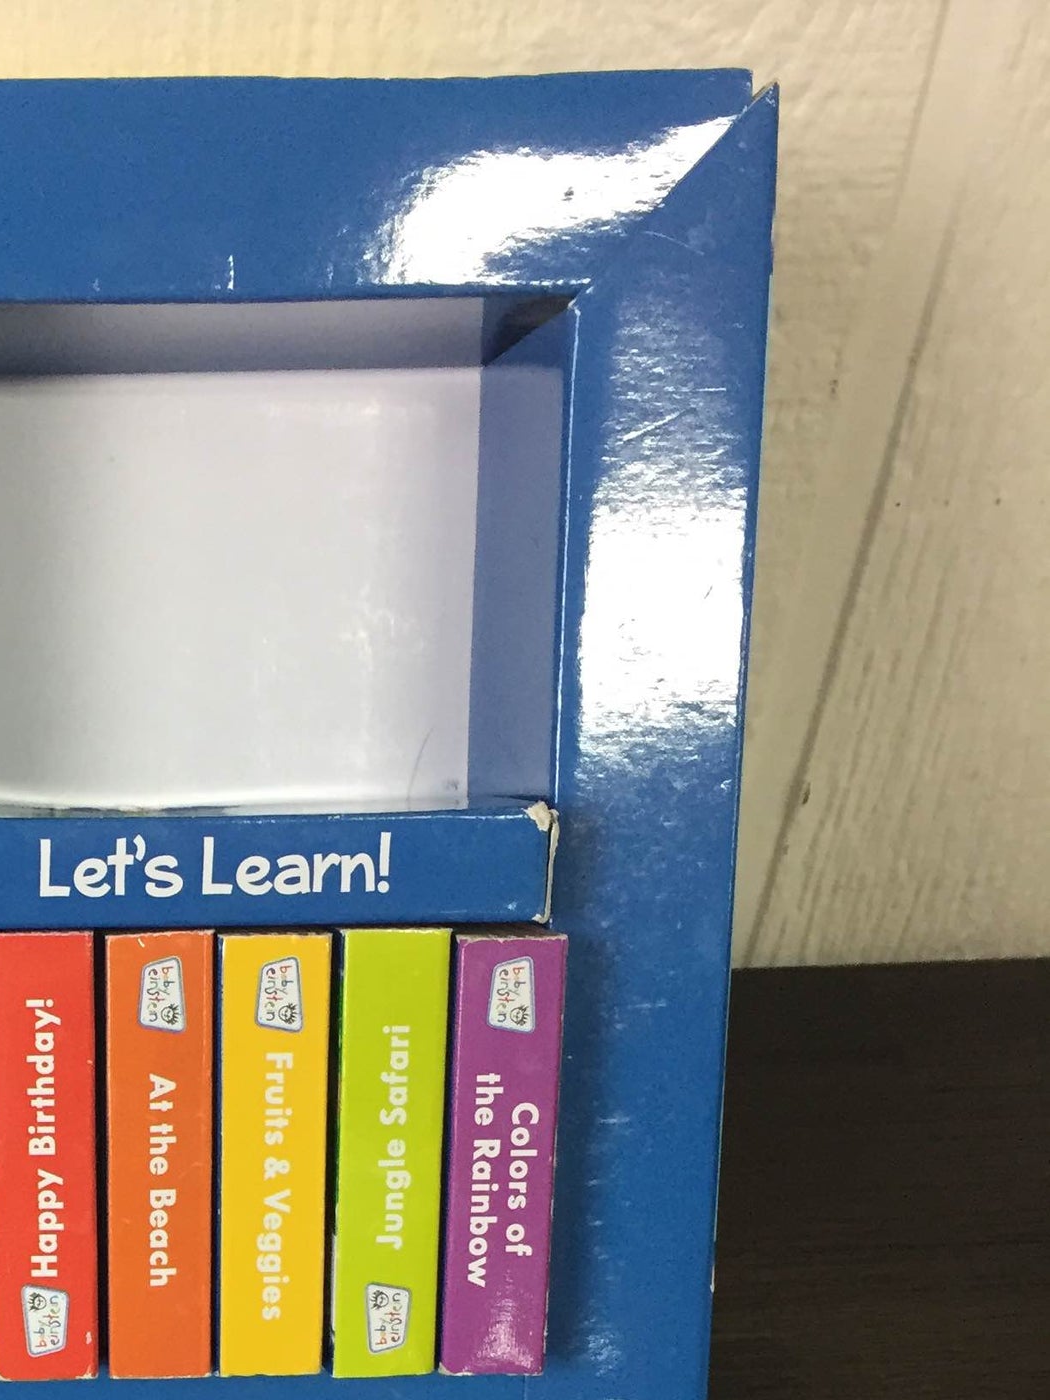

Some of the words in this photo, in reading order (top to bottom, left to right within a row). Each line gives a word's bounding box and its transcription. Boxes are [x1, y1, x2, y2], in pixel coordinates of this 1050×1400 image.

[39, 835, 184, 897] Let's
[202, 831, 391, 896] Learn!
[25, 998, 64, 1157] Birthday!
[148, 1072, 178, 1111] At
[265, 1051, 294, 1148] Fruits
[381, 1024, 411, 1126] Safari
[475, 1072, 505, 1128] the
[149, 1117, 177, 1176] the
[262, 1156, 291, 1182] &
[376, 1137, 411, 1250] Jungle
[507, 1101, 540, 1210] Colors
[31, 1169, 65, 1278] Happy
[149, 1187, 178, 1288] Beach
[256, 1188, 292, 1321] Veggies
[466, 1137, 502, 1288] Rainbow
[505, 1217, 534, 1257] of
